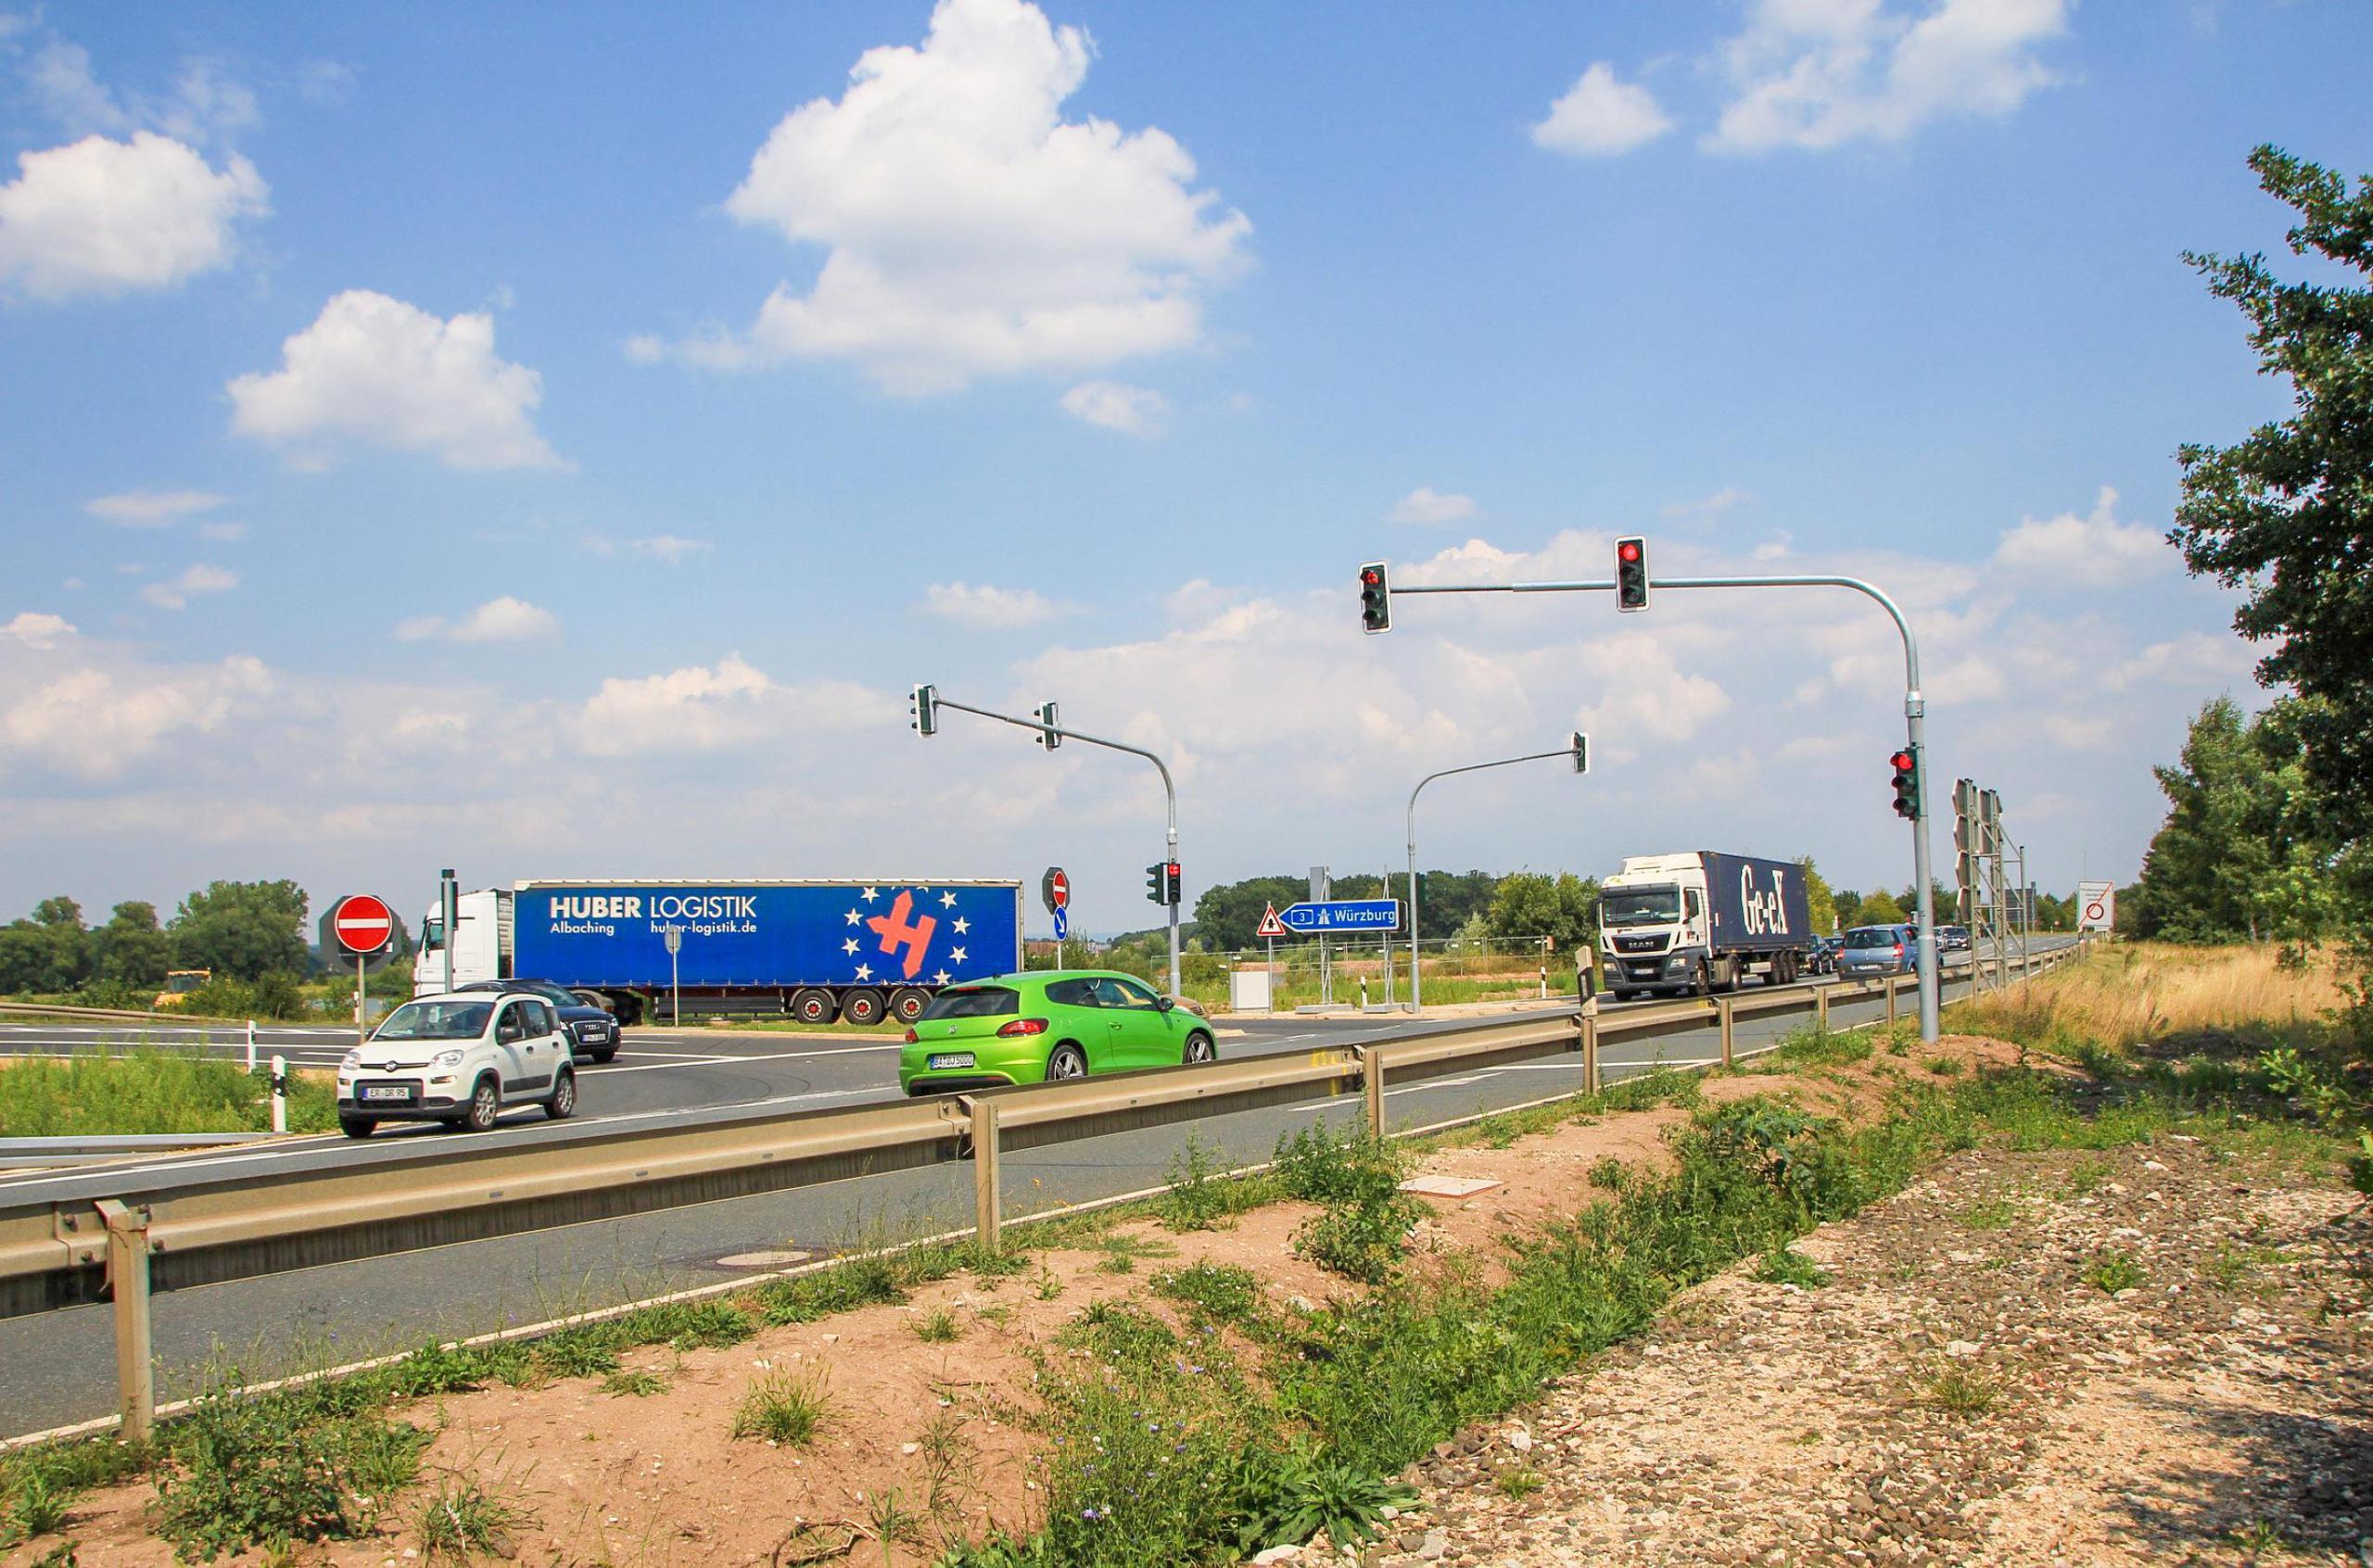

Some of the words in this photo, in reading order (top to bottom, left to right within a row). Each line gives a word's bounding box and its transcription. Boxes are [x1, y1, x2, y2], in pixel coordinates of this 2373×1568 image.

[550, 896, 642, 918] HUBER
[650, 896, 757, 918] LOGISTIK
[1300, 913, 1305, 922] 3
[1335, 908, 1395, 923] Würzburg
[550, 921, 615, 936] Albaching
